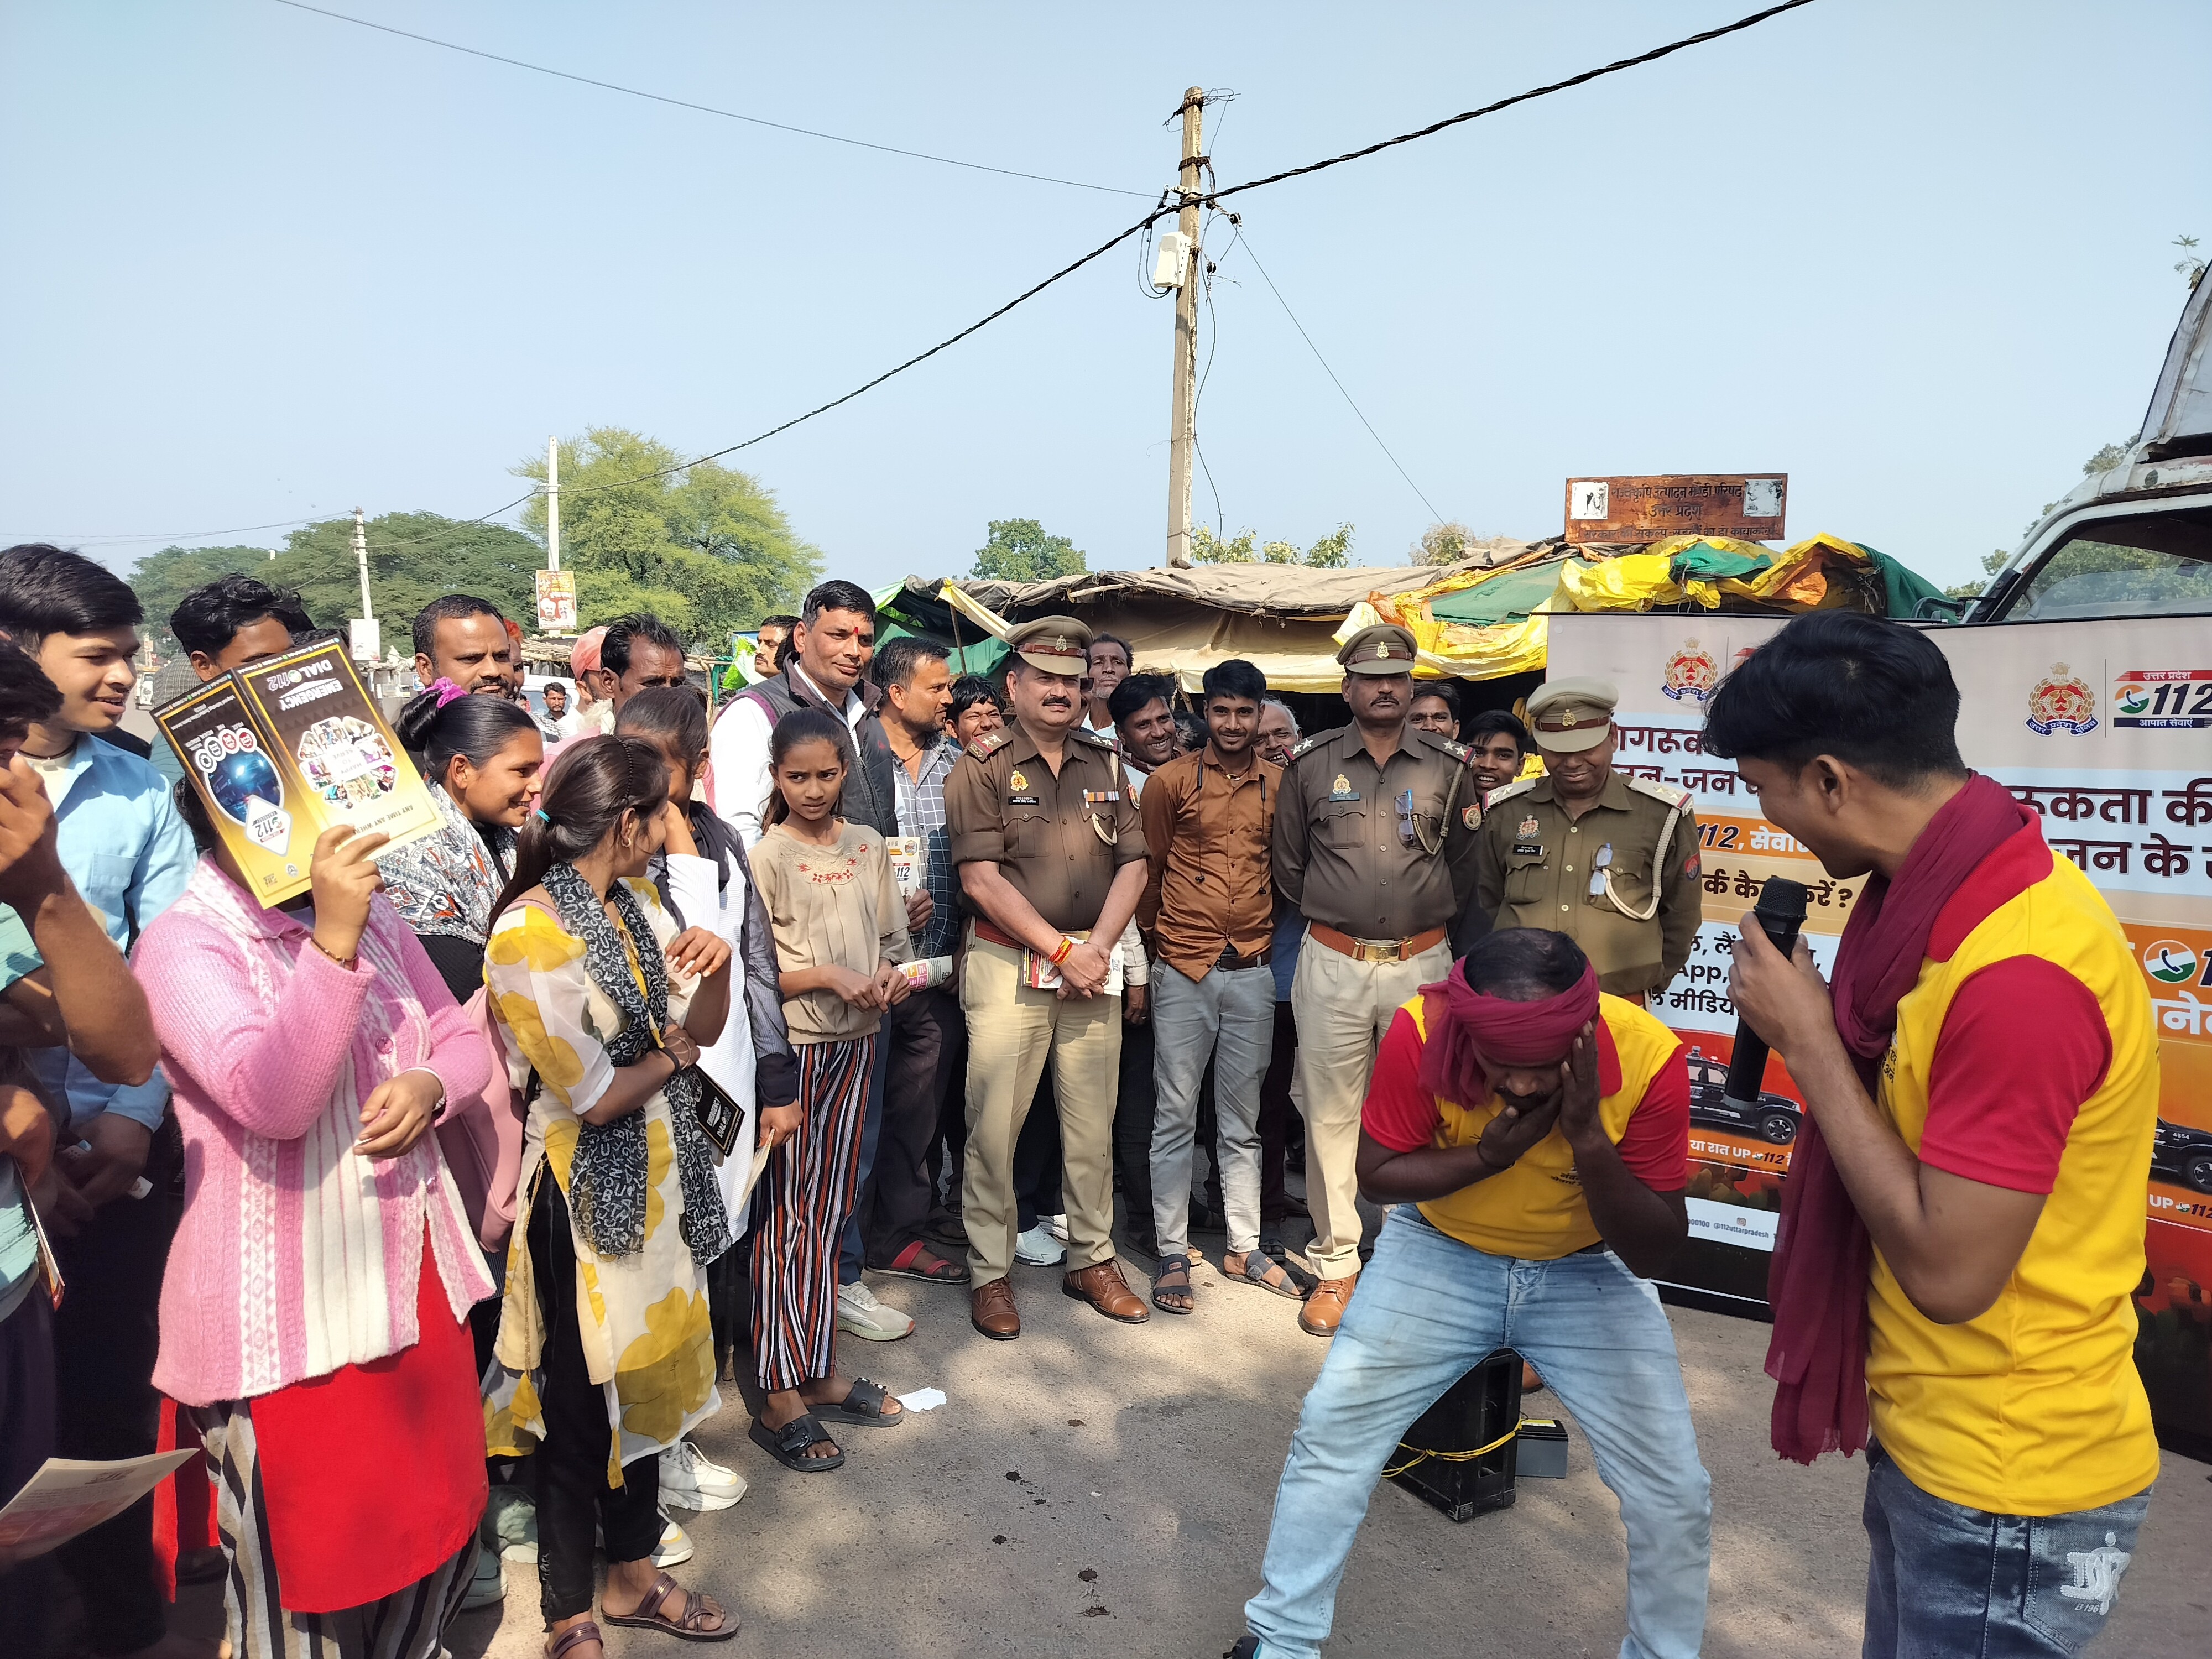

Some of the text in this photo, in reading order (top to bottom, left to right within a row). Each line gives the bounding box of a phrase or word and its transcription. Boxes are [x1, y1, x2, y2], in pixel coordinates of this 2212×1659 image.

[299, 659, 333, 678] DIAL
[2142, 670, 2192, 680] उत्तर प्रदेश
[267, 672, 290, 691] 112
[279, 680, 343, 711] EMERGENCY
[2152, 683, 2212, 715] 112
[386, 810, 401, 820] TIME
[402, 804, 413, 813] ANY
[255, 820, 273, 837] 112
[374, 817, 385, 826] ANY
[2140, 833, 2194, 878] के
[896, 867, 910, 877] 112
[717, 1123, 727, 1138] DIAL
[1689, 1140, 1706, 1152] या
[1707, 1142, 1730, 1156] रात
[1733, 1146, 1751, 1159] UP
[1764, 1152, 1786, 1165] 112
[2149, 1194, 2174, 1209] UP
[1713, 1222, 1769, 1238] @112uttarpradesh
